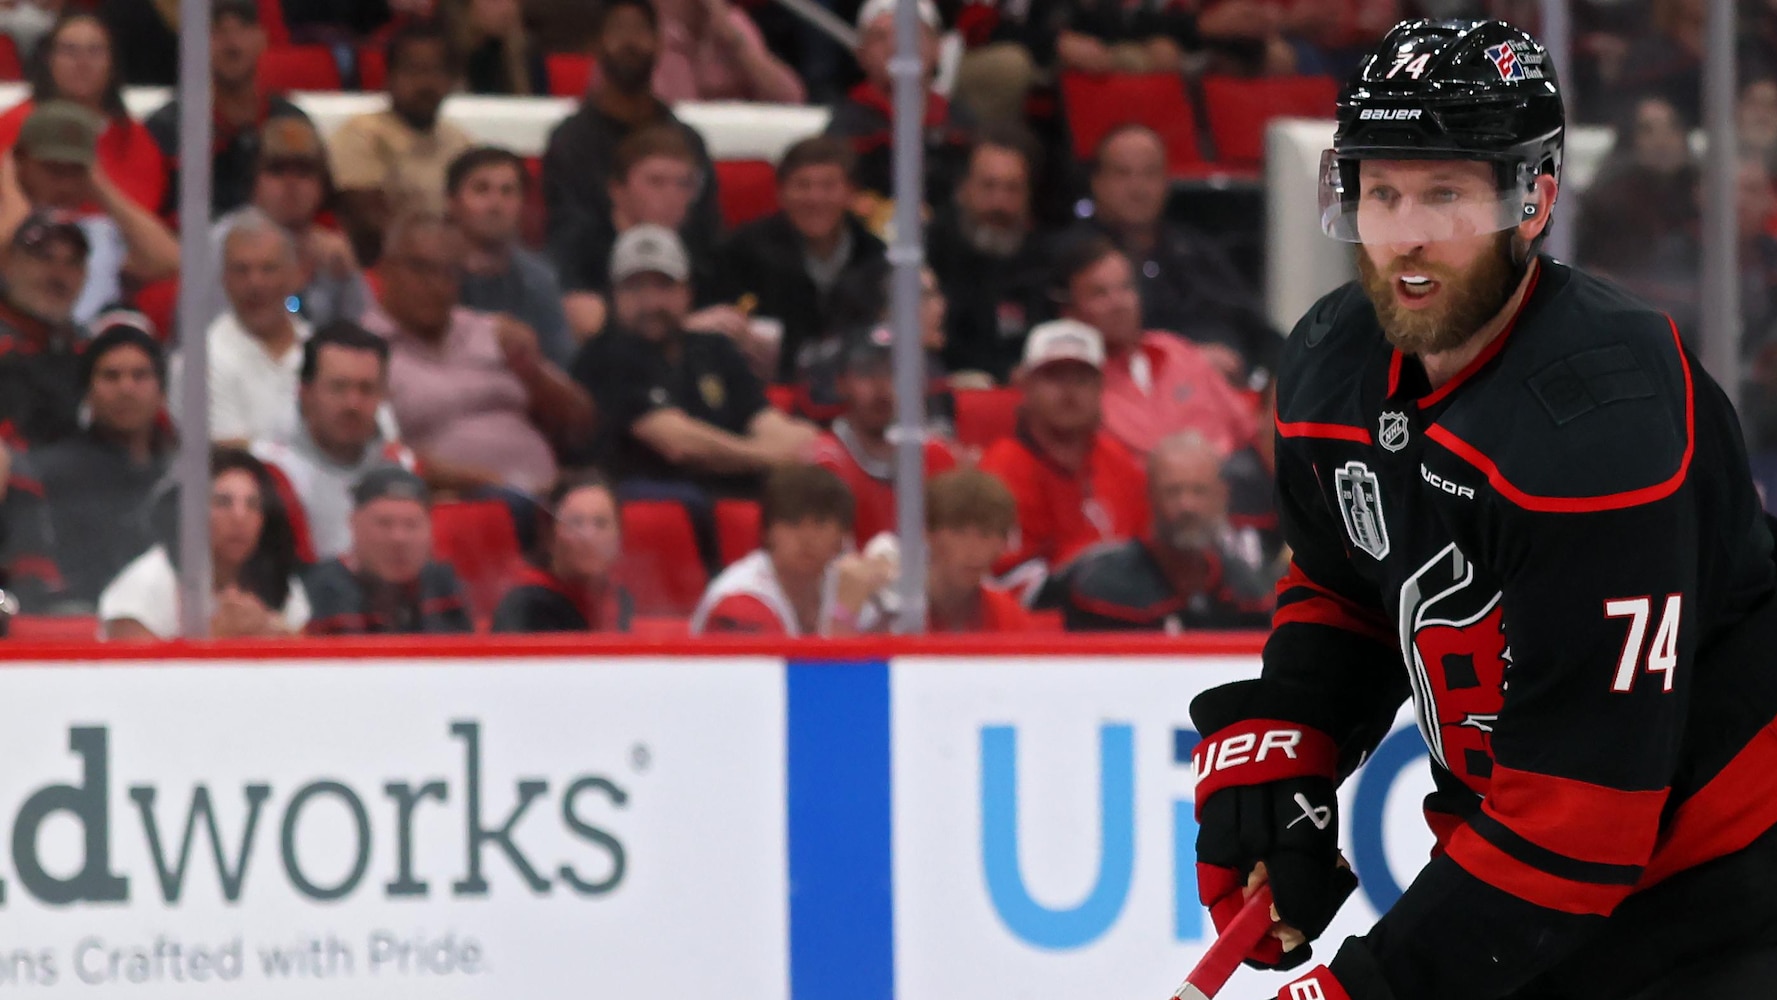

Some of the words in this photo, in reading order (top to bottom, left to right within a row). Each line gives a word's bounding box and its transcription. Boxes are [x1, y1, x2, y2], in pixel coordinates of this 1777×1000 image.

[1386, 53, 1431, 80] 74
[1358, 108, 1423, 121] BAUER
[1385, 420, 1403, 444] NHL
[1604, 593, 1682, 693] 74
[0, 718, 629, 906] dworks
[73, 934, 245, 986] Crafted
[258, 930, 353, 981] with
[368, 929, 490, 977] Pride.
